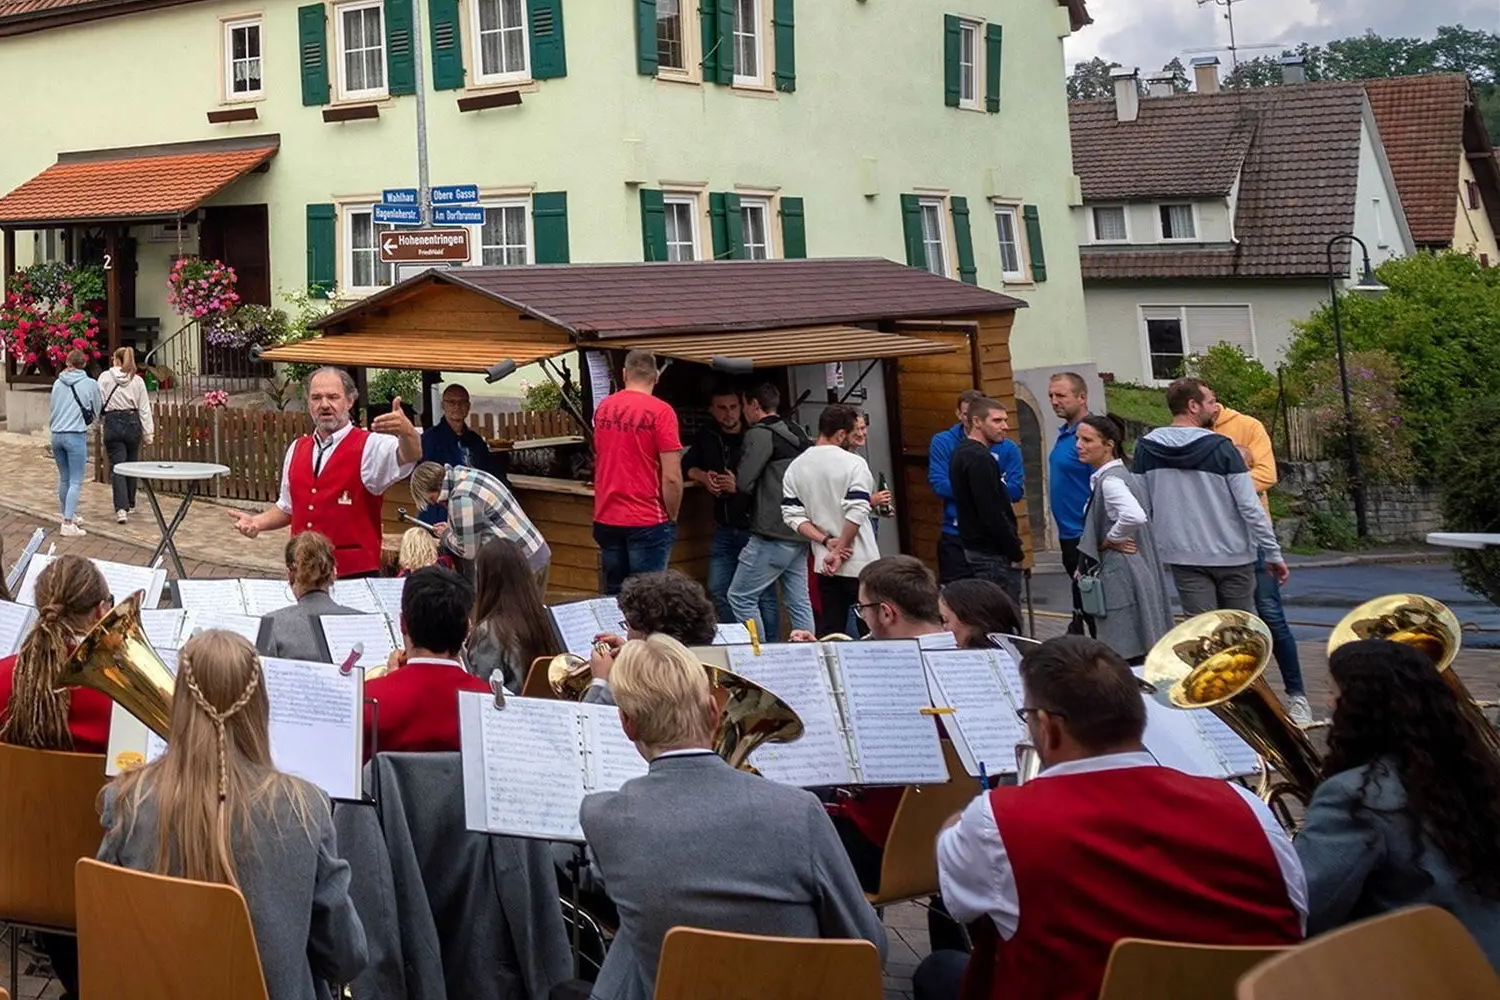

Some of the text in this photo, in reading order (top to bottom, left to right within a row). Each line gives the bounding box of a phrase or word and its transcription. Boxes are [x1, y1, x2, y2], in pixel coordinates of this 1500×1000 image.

[386, 193, 414, 202] Wahlhau
[434, 188, 476, 200] Obere Gasse
[435, 210, 482, 221] Am Dorfbrunnen
[398, 233, 464, 247] Hohenentringen
[103, 254, 112, 269] 2
